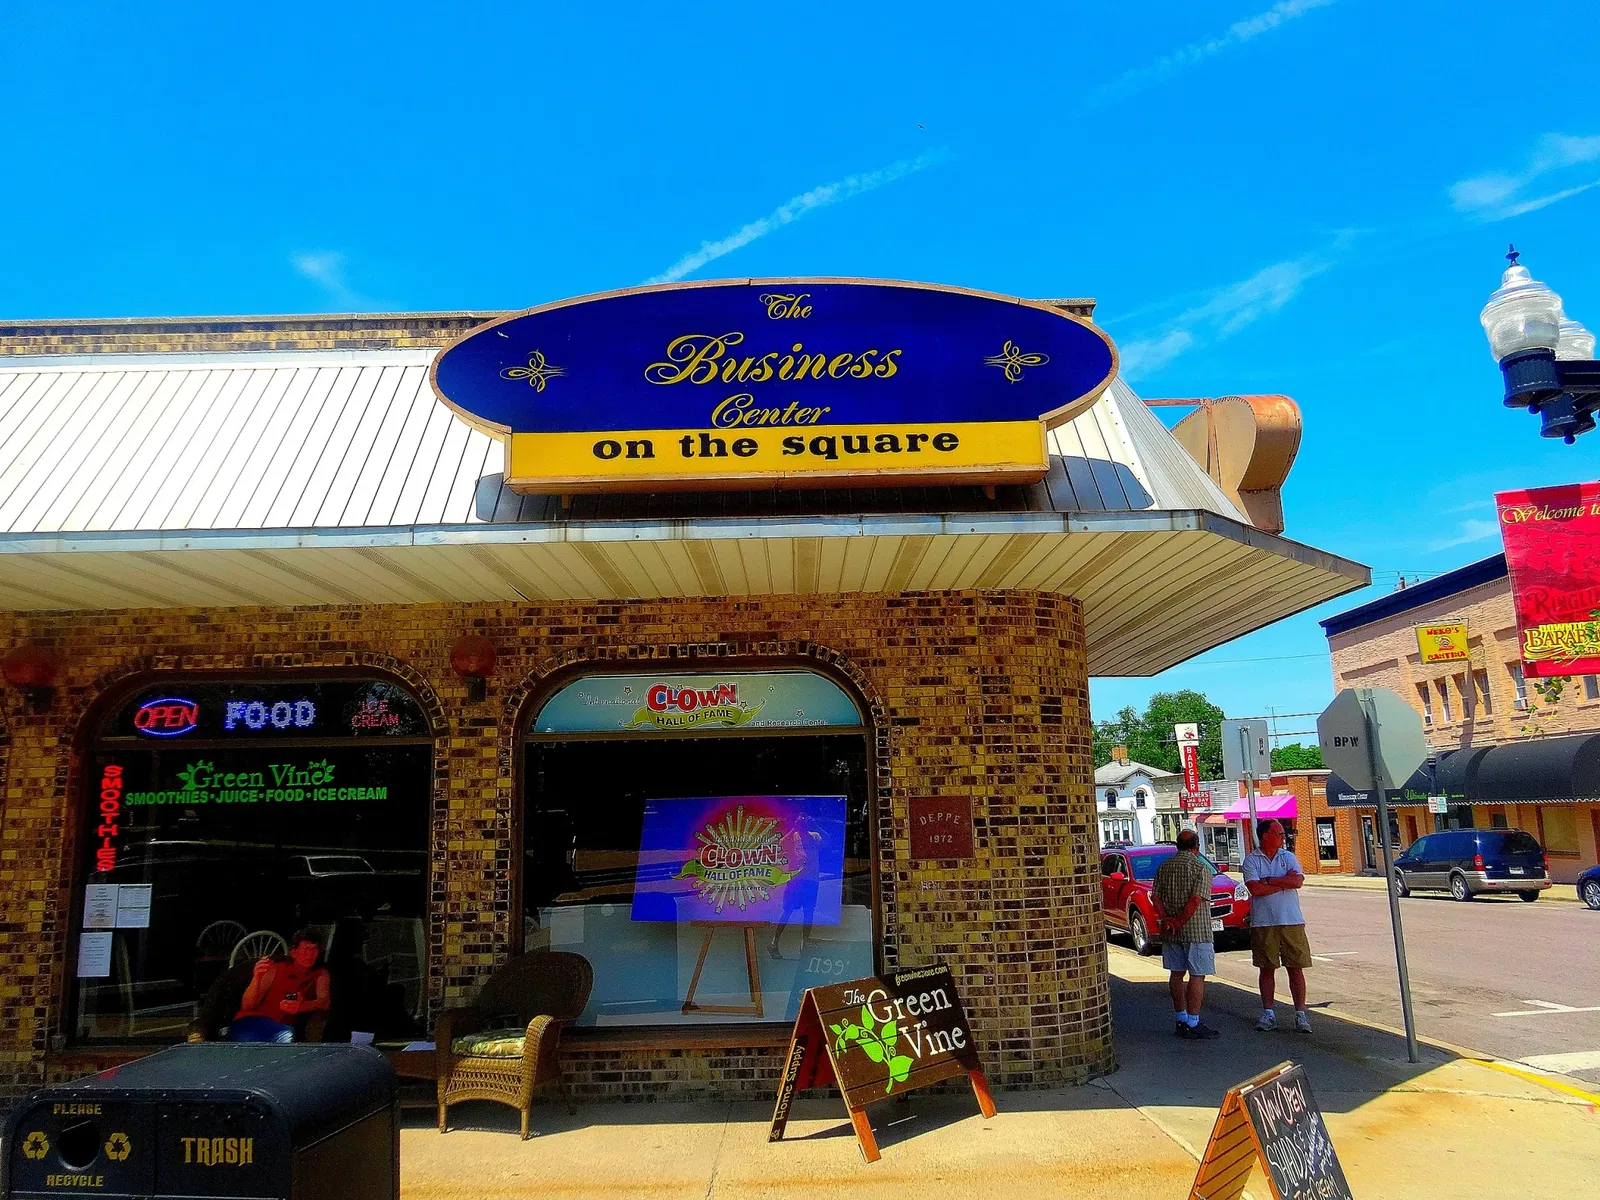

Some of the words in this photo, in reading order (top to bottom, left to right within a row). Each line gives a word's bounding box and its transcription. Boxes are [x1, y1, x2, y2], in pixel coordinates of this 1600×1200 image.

[759, 294, 813, 319] The
[645, 331, 903, 385] Business
[711, 393, 831, 428] Center
[593, 438, 656, 459] on
[679, 432, 759, 458] the
[782, 425, 959, 461] square
[1501, 504, 1586, 524] Welcome
[361, 700, 389, 712] ICE
[646, 682, 738, 712] CLOWN
[134, 704, 199, 729] OPEN
[224, 700, 317, 729] FOOD
[351, 713, 399, 728] CREAM
[656, 714, 686, 726] HALL
[688, 712, 701, 724] OF
[704, 709, 733, 721] FAME
[1333, 735, 1359, 748] BPW
[191, 764, 265, 788] Green
[269, 763, 326, 786] Vine
[1186, 746, 1196, 791] BADGER
[125, 791, 209, 806] SMOOTHIES
[215, 789, 259, 803] JUICE
[265, 788, 304, 802] FOOD
[96, 764, 124, 871] SMOOTHIES
[920, 812, 961, 826] DEPPE
[929, 834, 953, 843] 1972
[701, 844, 779, 869] CLOWN
[704, 869, 728, 881] HALL
[729, 871, 742, 879] OF
[743, 867, 772, 878] FAME
[842, 988, 866, 1006] The
[867, 988, 952, 1024] Green
[898, 1019, 966, 1059] Vine
[775, 1083, 793, 1121] Home
[786, 1044, 806, 1082] Supply
[53, 1103, 102, 1115] PLEASE
[180, 1137, 254, 1167] TRASH
[46, 1174, 104, 1187] RECYCLE
